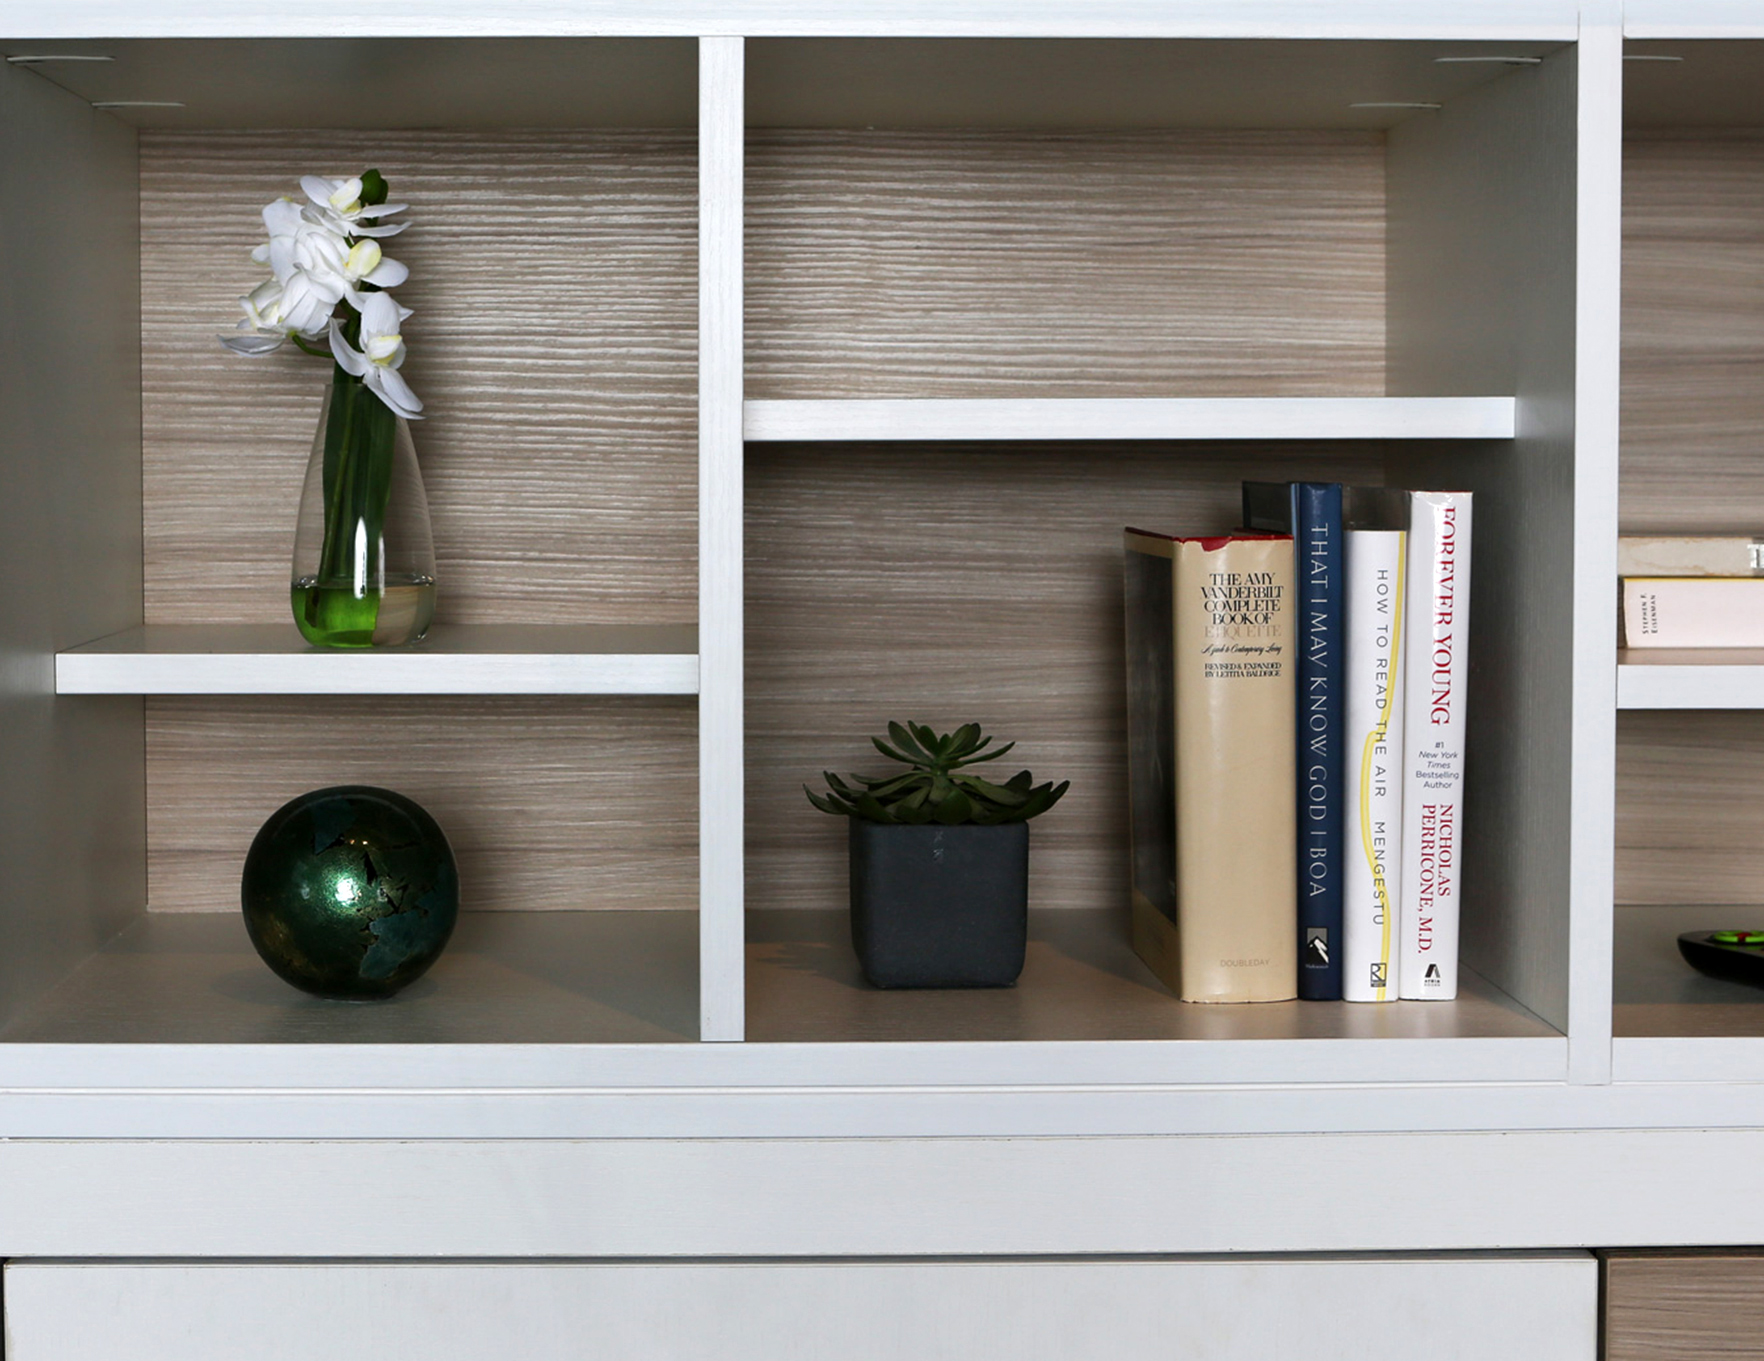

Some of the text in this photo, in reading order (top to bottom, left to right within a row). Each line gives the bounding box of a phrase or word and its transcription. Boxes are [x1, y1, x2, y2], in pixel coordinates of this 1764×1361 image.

[1310, 522, 1329, 589] THAT
[1209, 572, 1276, 586] THE AMY
[1200, 586, 1284, 599] VANDERBILT
[1203, 599, 1281, 613] COMPLETE
[1212, 612, 1274, 625] BOOK OF
[1430, 506, 1456, 725] FOREVER YOUNG
[1204, 625, 1282, 640] ETIQUETTE
[1308, 611, 1328, 668] MAY
[1309, 676, 1328, 757] KNOW
[1373, 569, 1388, 926] HOW TO READ THE AIR MENGESTU
[1434, 741, 1444, 749] #1
[1418, 751, 1458, 759] New York
[1427, 761, 1451, 769] Times
[1415, 770, 1460, 780] Bestselling
[1423, 781, 1453, 789] Author
[1309, 765, 1328, 821] GOD
[1436, 803, 1454, 897] NICHOLAS
[1309, 847, 1327, 897] BOA
[1417, 804, 1437, 954] PERRICONE, M.D.
[1220, 959, 1270, 968] DOUBLEDAY
